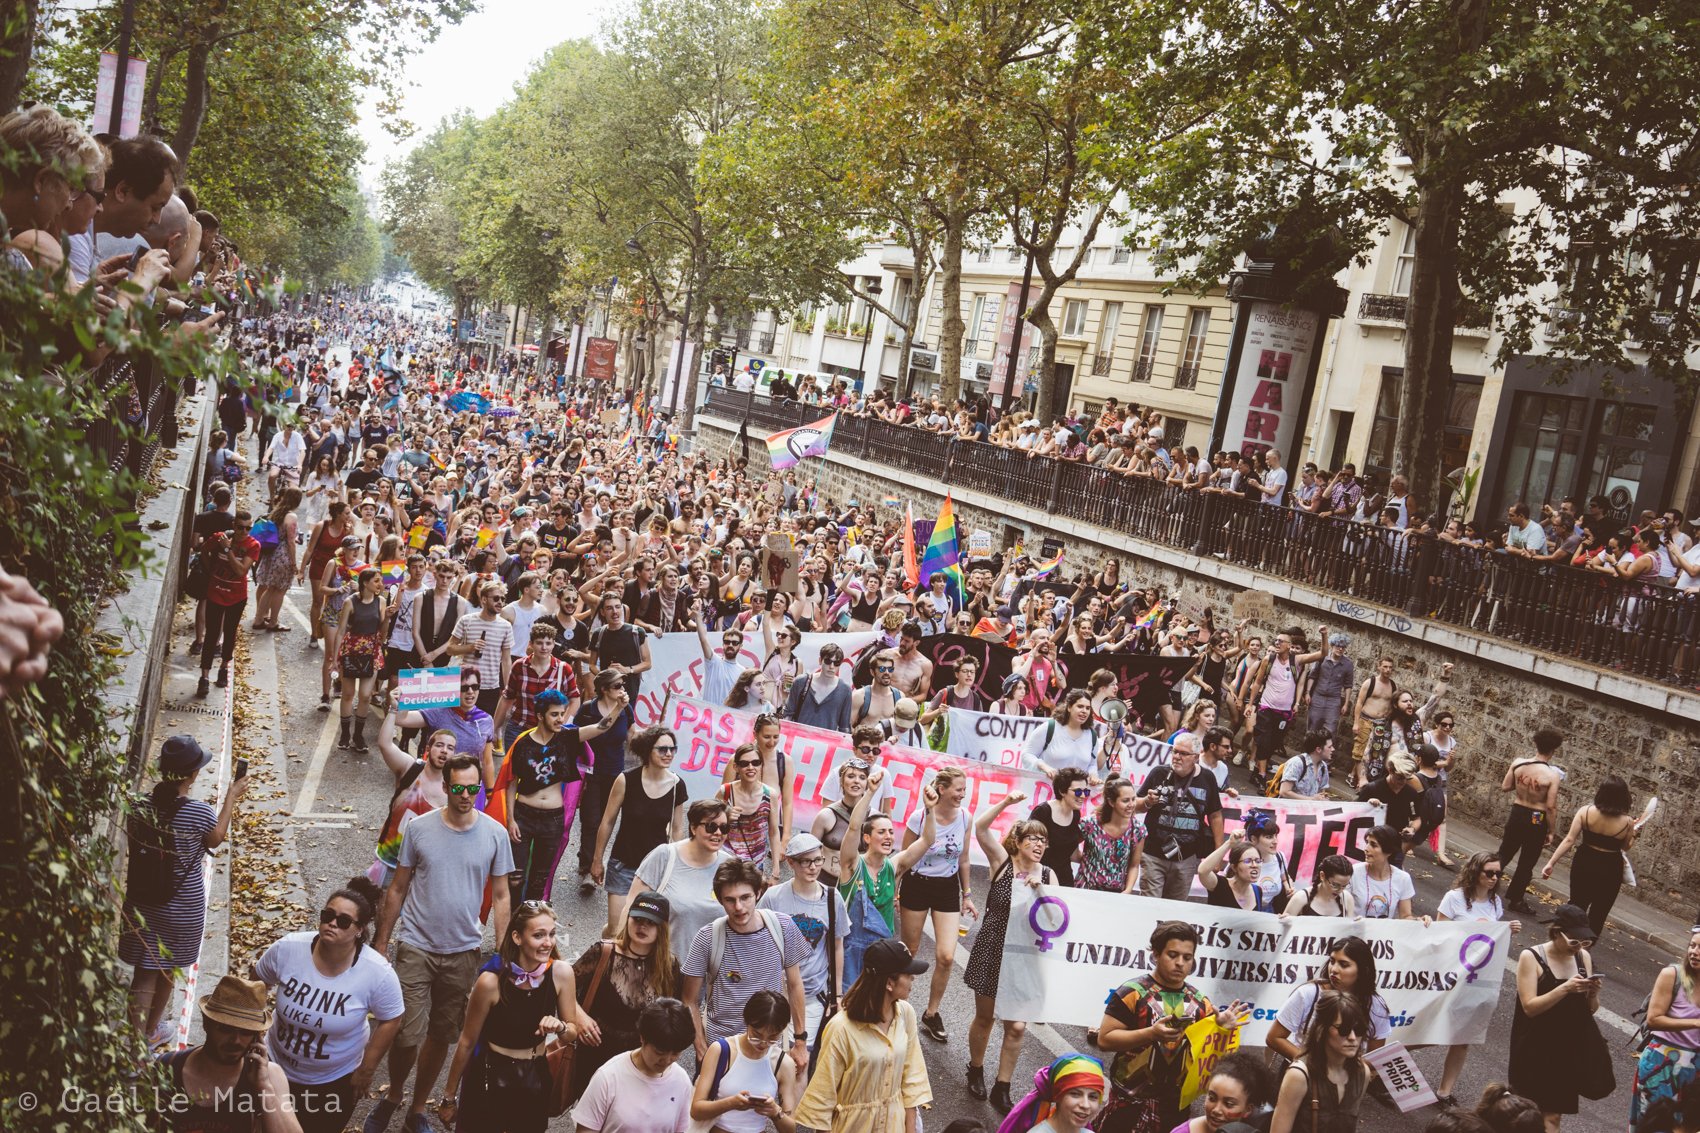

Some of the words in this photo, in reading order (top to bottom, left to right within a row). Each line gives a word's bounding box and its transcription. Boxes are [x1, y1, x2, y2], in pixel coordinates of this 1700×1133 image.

[1254, 313, 1314, 331] RENAISSANCE
[673, 700, 736, 744] PAS
[975, 715, 1044, 741] CONT
[679, 736, 737, 777] DE
[1237, 930, 1283, 953] SIN
[283, 1005, 311, 1025] LIKE
[314, 1017, 324, 1029] A
[277, 1024, 330, 1060] GIRL
[1382, 1061, 1408, 1092] PRIDE
[1392, 1056, 1419, 1088] HAPPY
